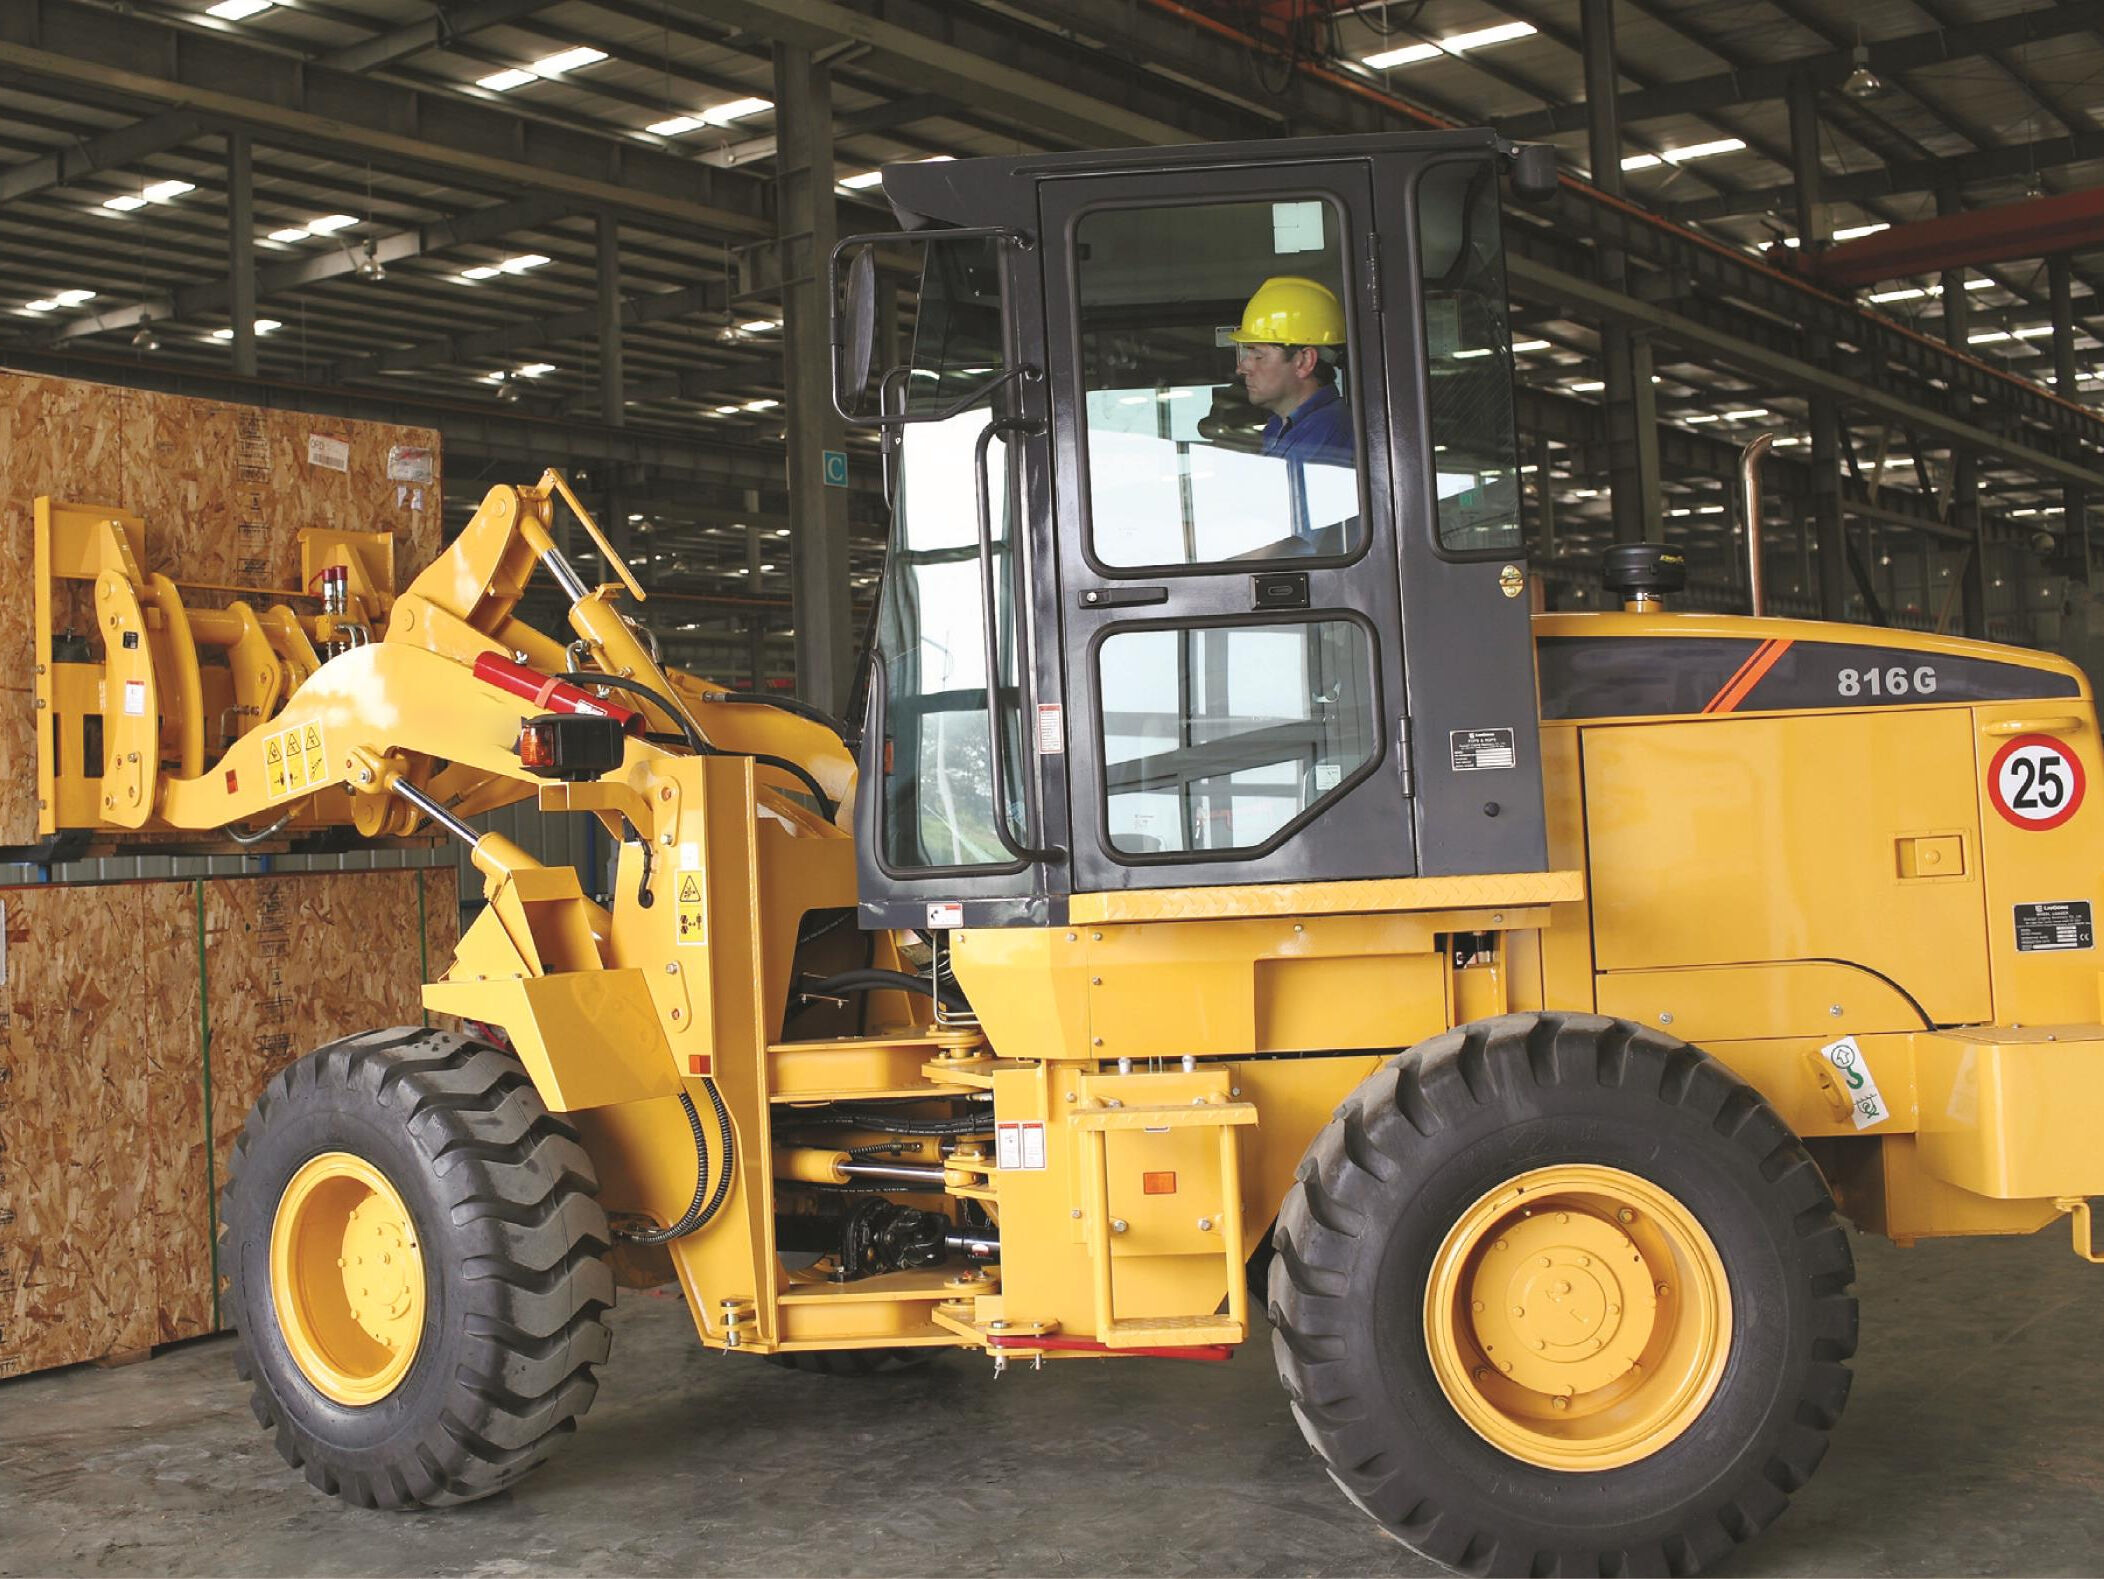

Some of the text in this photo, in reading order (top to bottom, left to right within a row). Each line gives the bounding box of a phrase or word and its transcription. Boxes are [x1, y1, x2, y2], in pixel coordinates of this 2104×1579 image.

[828, 456, 843, 481] C
[1838, 666, 1937, 697] 816G
[2011, 755, 2064, 809] 25
